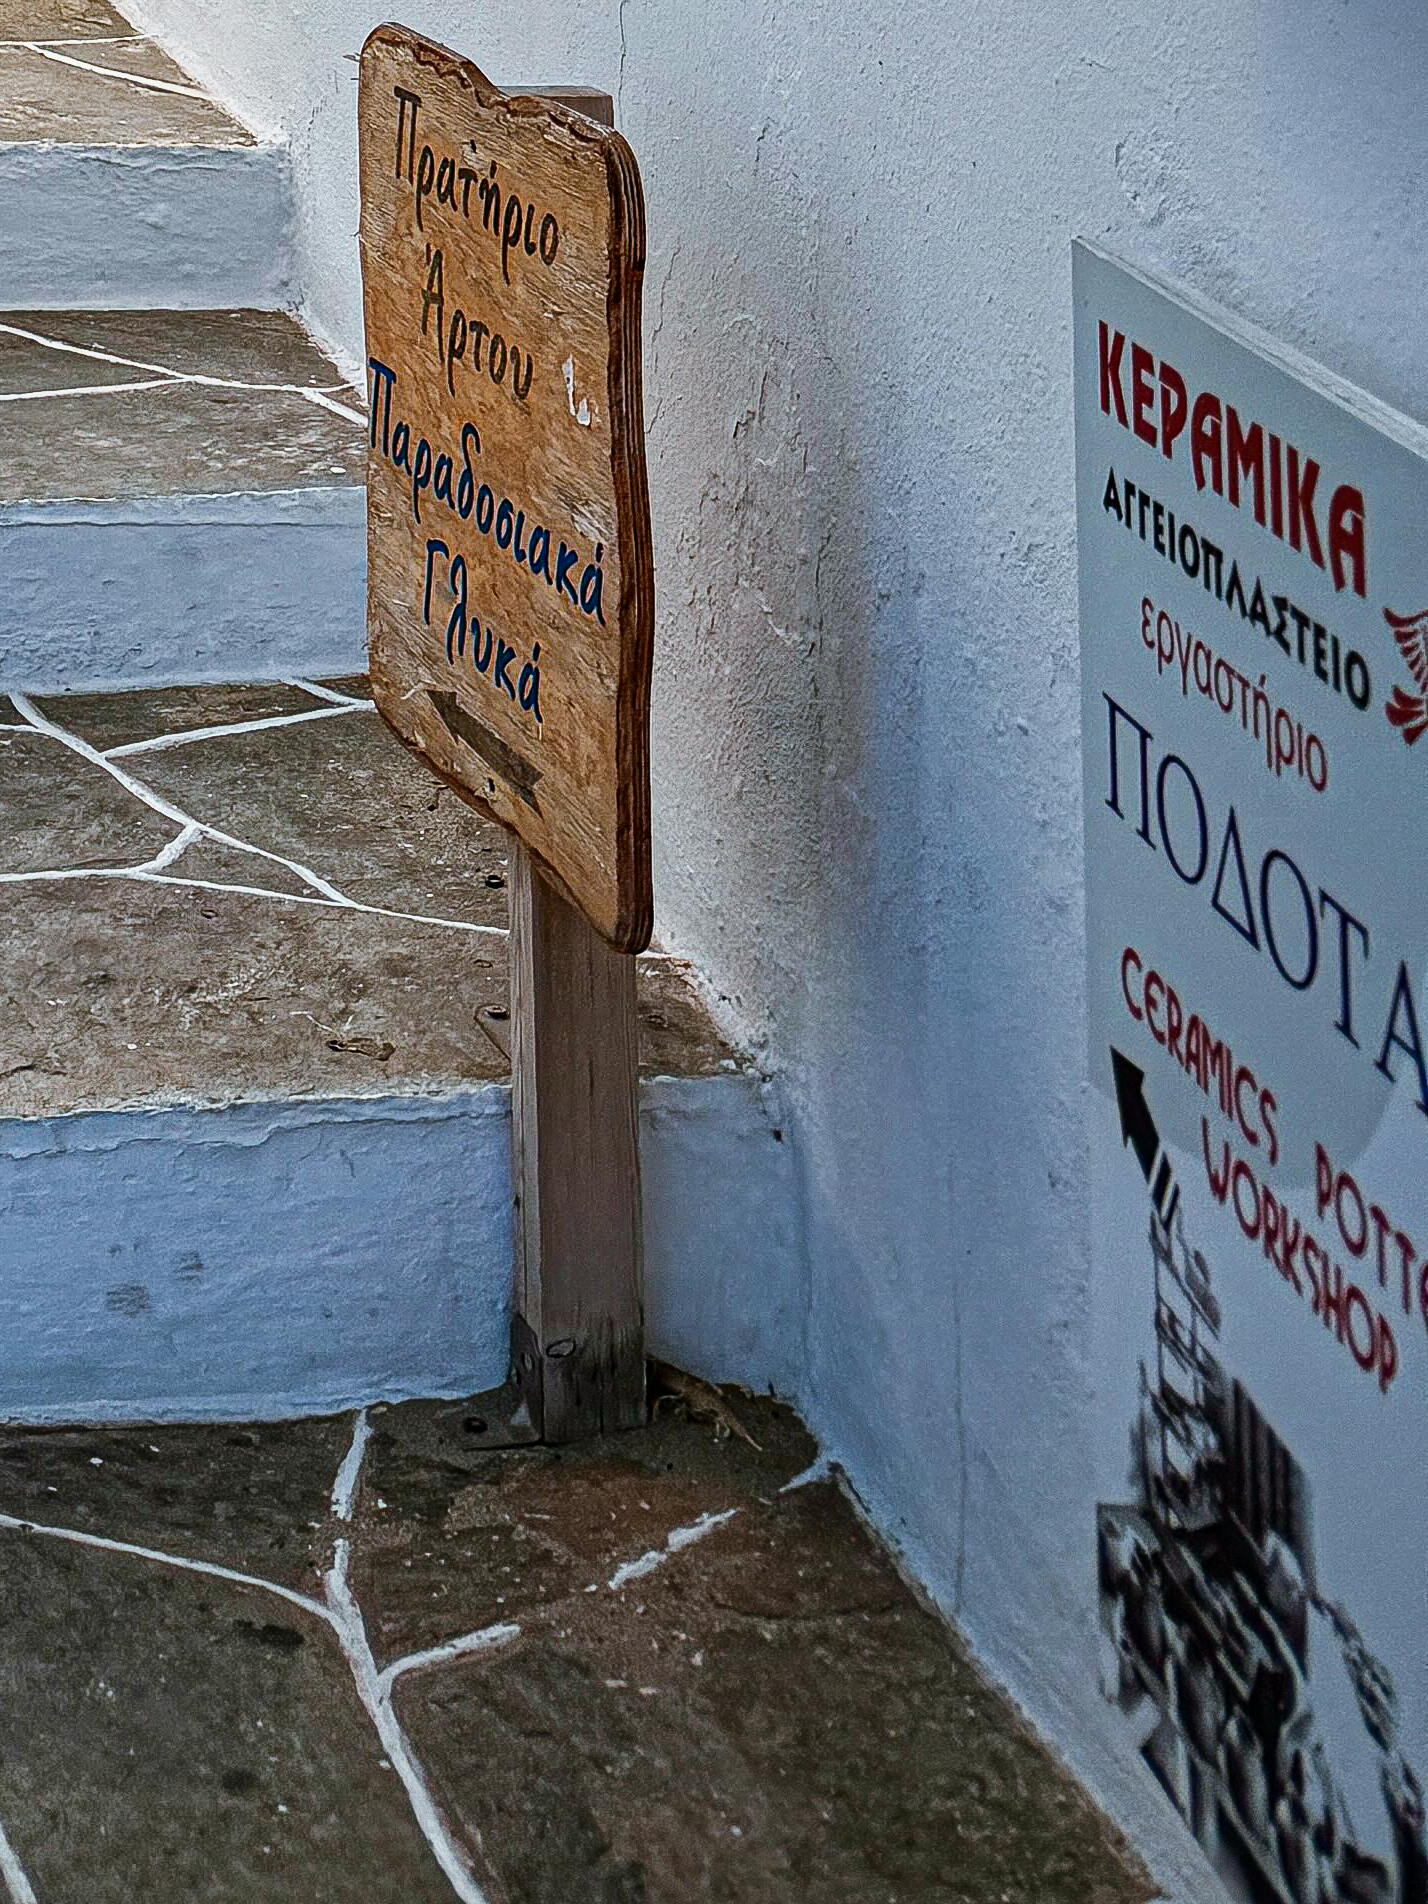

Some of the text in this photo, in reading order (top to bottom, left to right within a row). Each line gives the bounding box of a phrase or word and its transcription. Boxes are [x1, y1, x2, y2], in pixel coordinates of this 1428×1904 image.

[394, 86, 559, 285] Πρατήριο
[368, 357, 606, 627] Παραδοσιακά
[1098, 319, 1367, 598] ΚΕΡΑΜΙΚΑ
[425, 538, 543, 724] Γλυκά
[1103, 466, 1372, 712] ΑΓΓΕΙΟΠΛΑΣΤΕΙΟ
[1140, 596, 1329, 792] εργαστήριο
[1121, 947, 1279, 1167] CERAMICS
[1201, 1116, 1398, 1394] WORKSHOP
